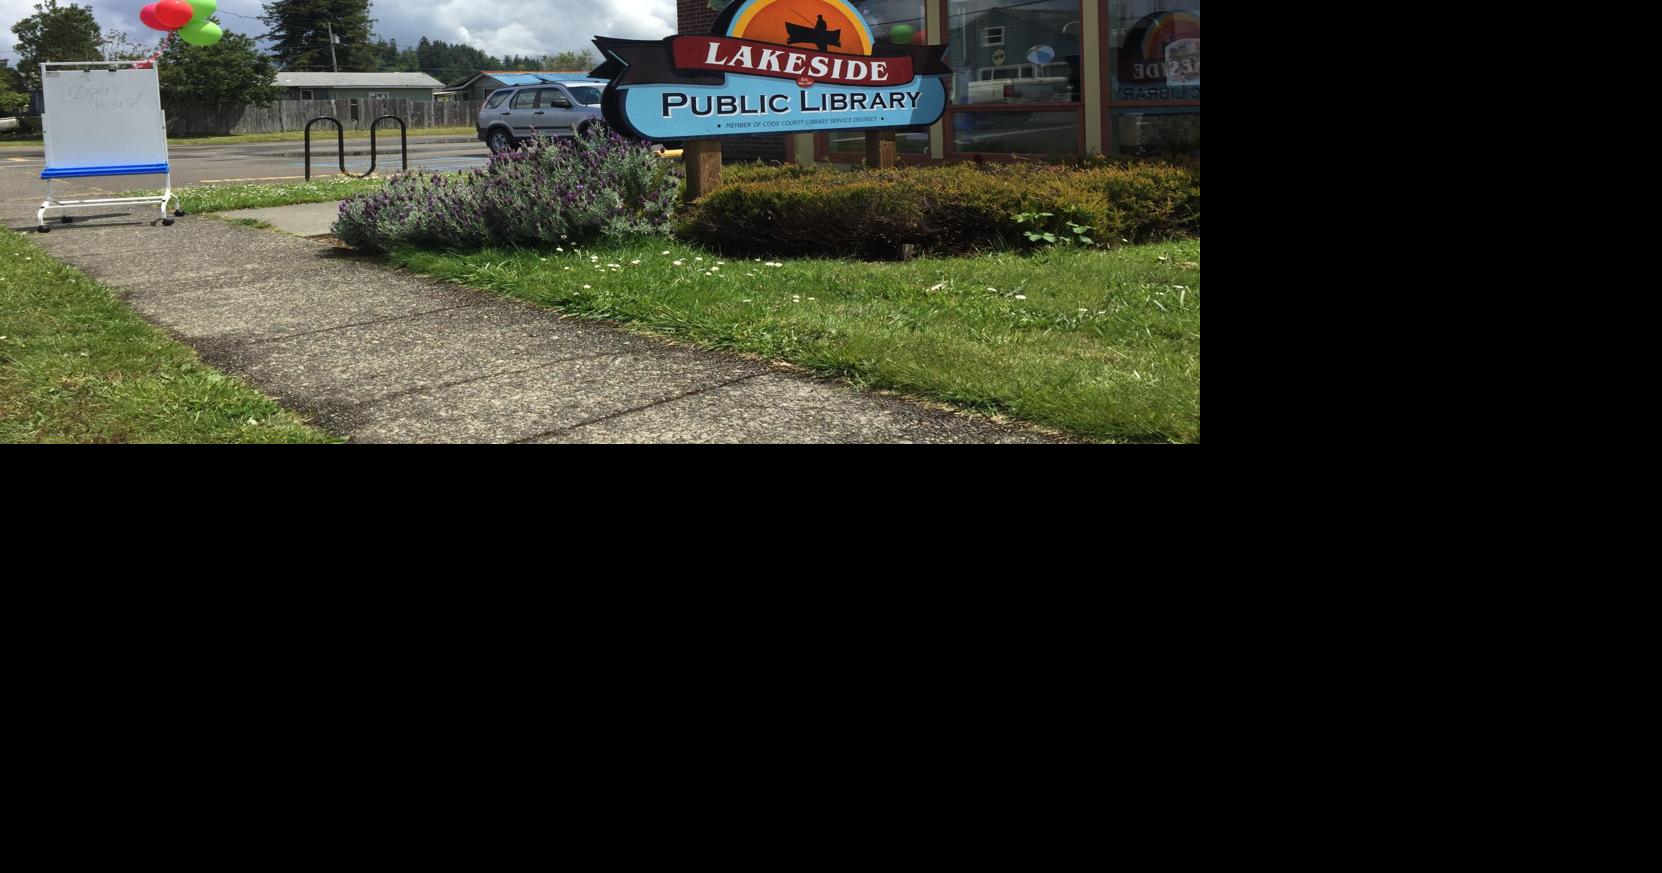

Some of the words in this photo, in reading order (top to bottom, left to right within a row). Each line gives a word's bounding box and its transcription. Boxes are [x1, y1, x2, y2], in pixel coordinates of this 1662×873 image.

[704, 41, 889, 81] LAKESIDE
[68, 85, 118, 101] Open
[661, 91, 791, 119] PUBLIC
[799, 90, 921, 114] LIBRARY
